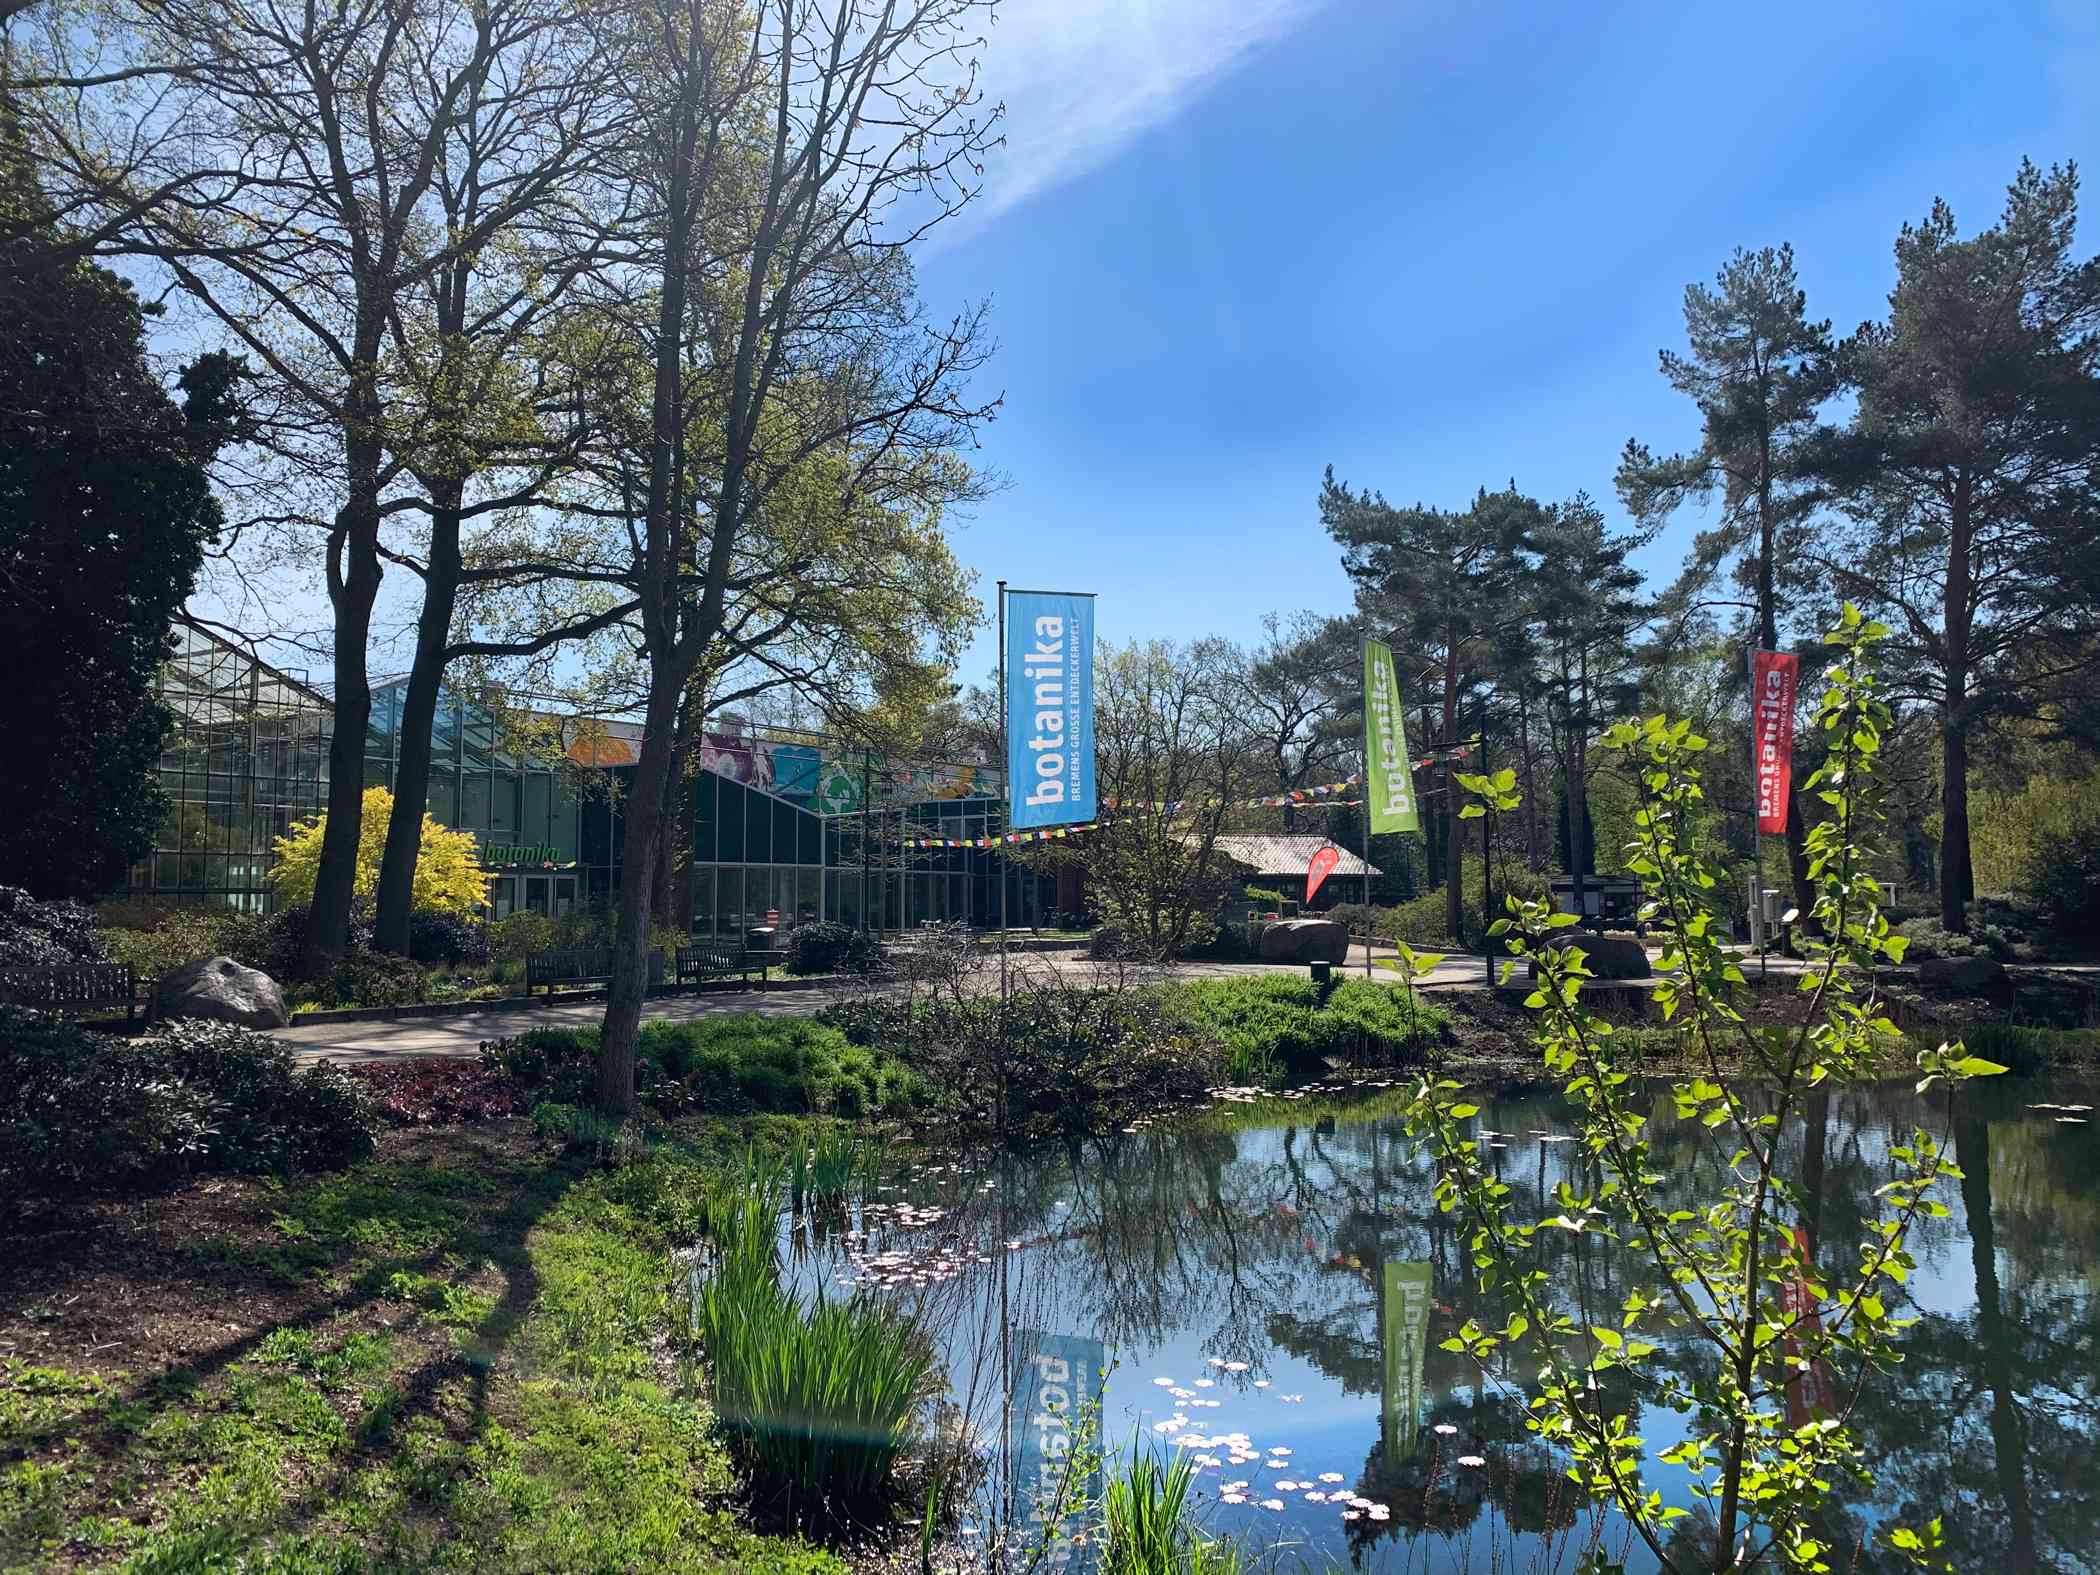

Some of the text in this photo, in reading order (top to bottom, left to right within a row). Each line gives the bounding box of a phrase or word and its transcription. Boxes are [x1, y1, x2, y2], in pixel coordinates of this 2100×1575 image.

[1024, 616, 1065, 807] botanika
[1070, 616, 1081, 802] BREMENS GROSSE ENTDECKERWELT
[1371, 660, 1410, 816] botanika
[1758, 670, 1782, 818] botanika
